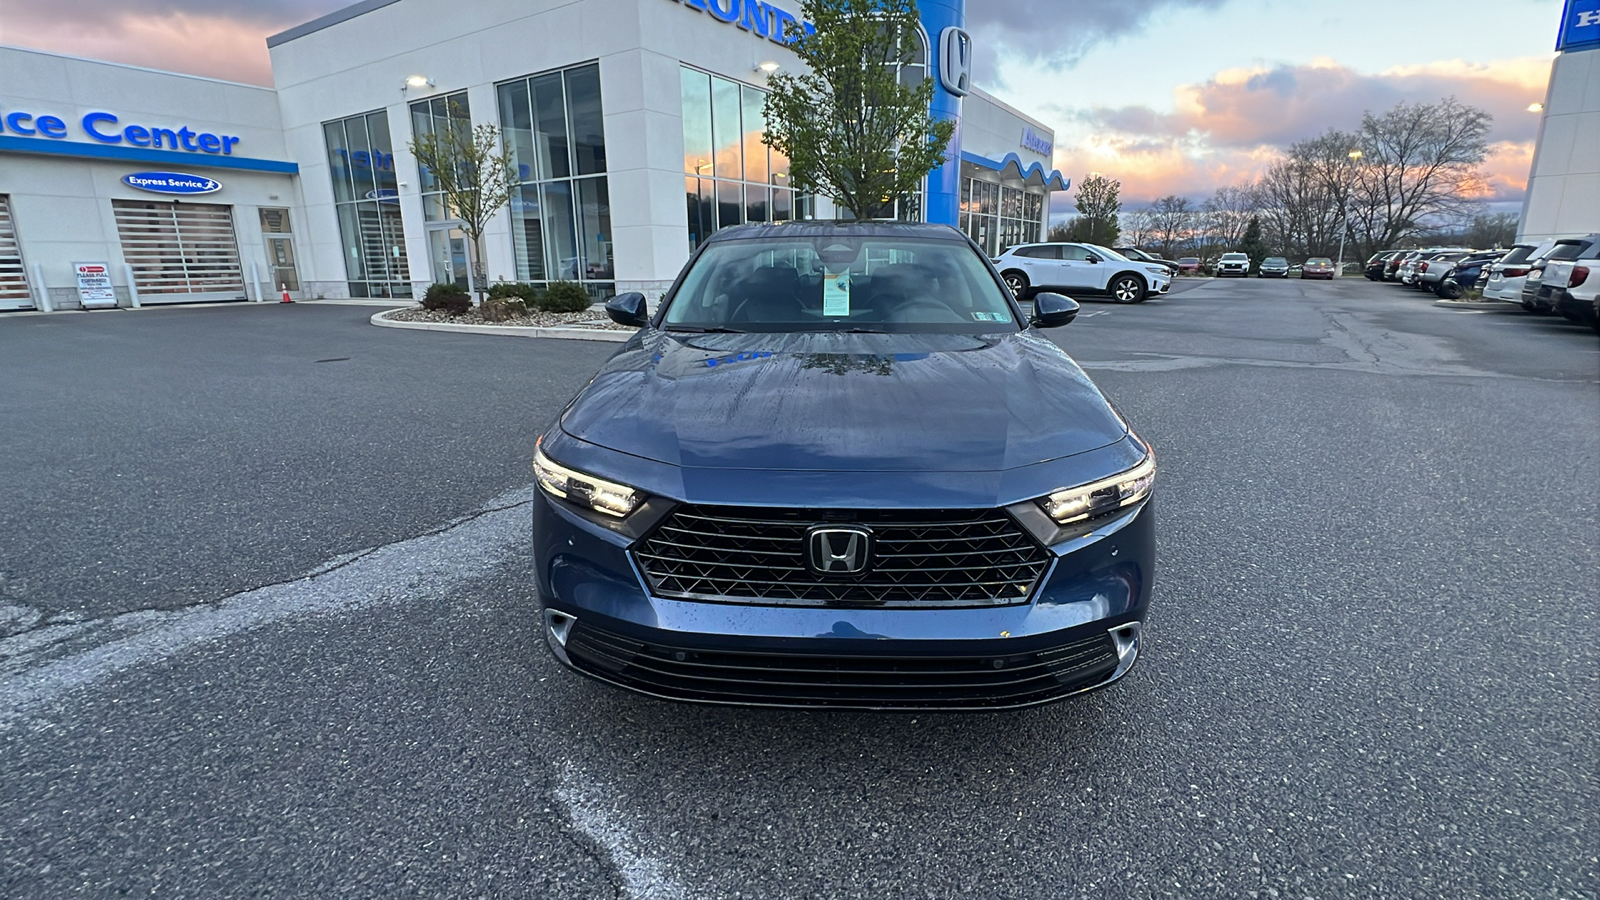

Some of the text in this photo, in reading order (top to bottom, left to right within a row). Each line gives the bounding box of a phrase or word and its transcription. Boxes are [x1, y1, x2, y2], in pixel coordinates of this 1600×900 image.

[671, 0, 816, 51] OND
[82, 111, 240, 155] Center
[129, 176, 203, 188] Express Service
